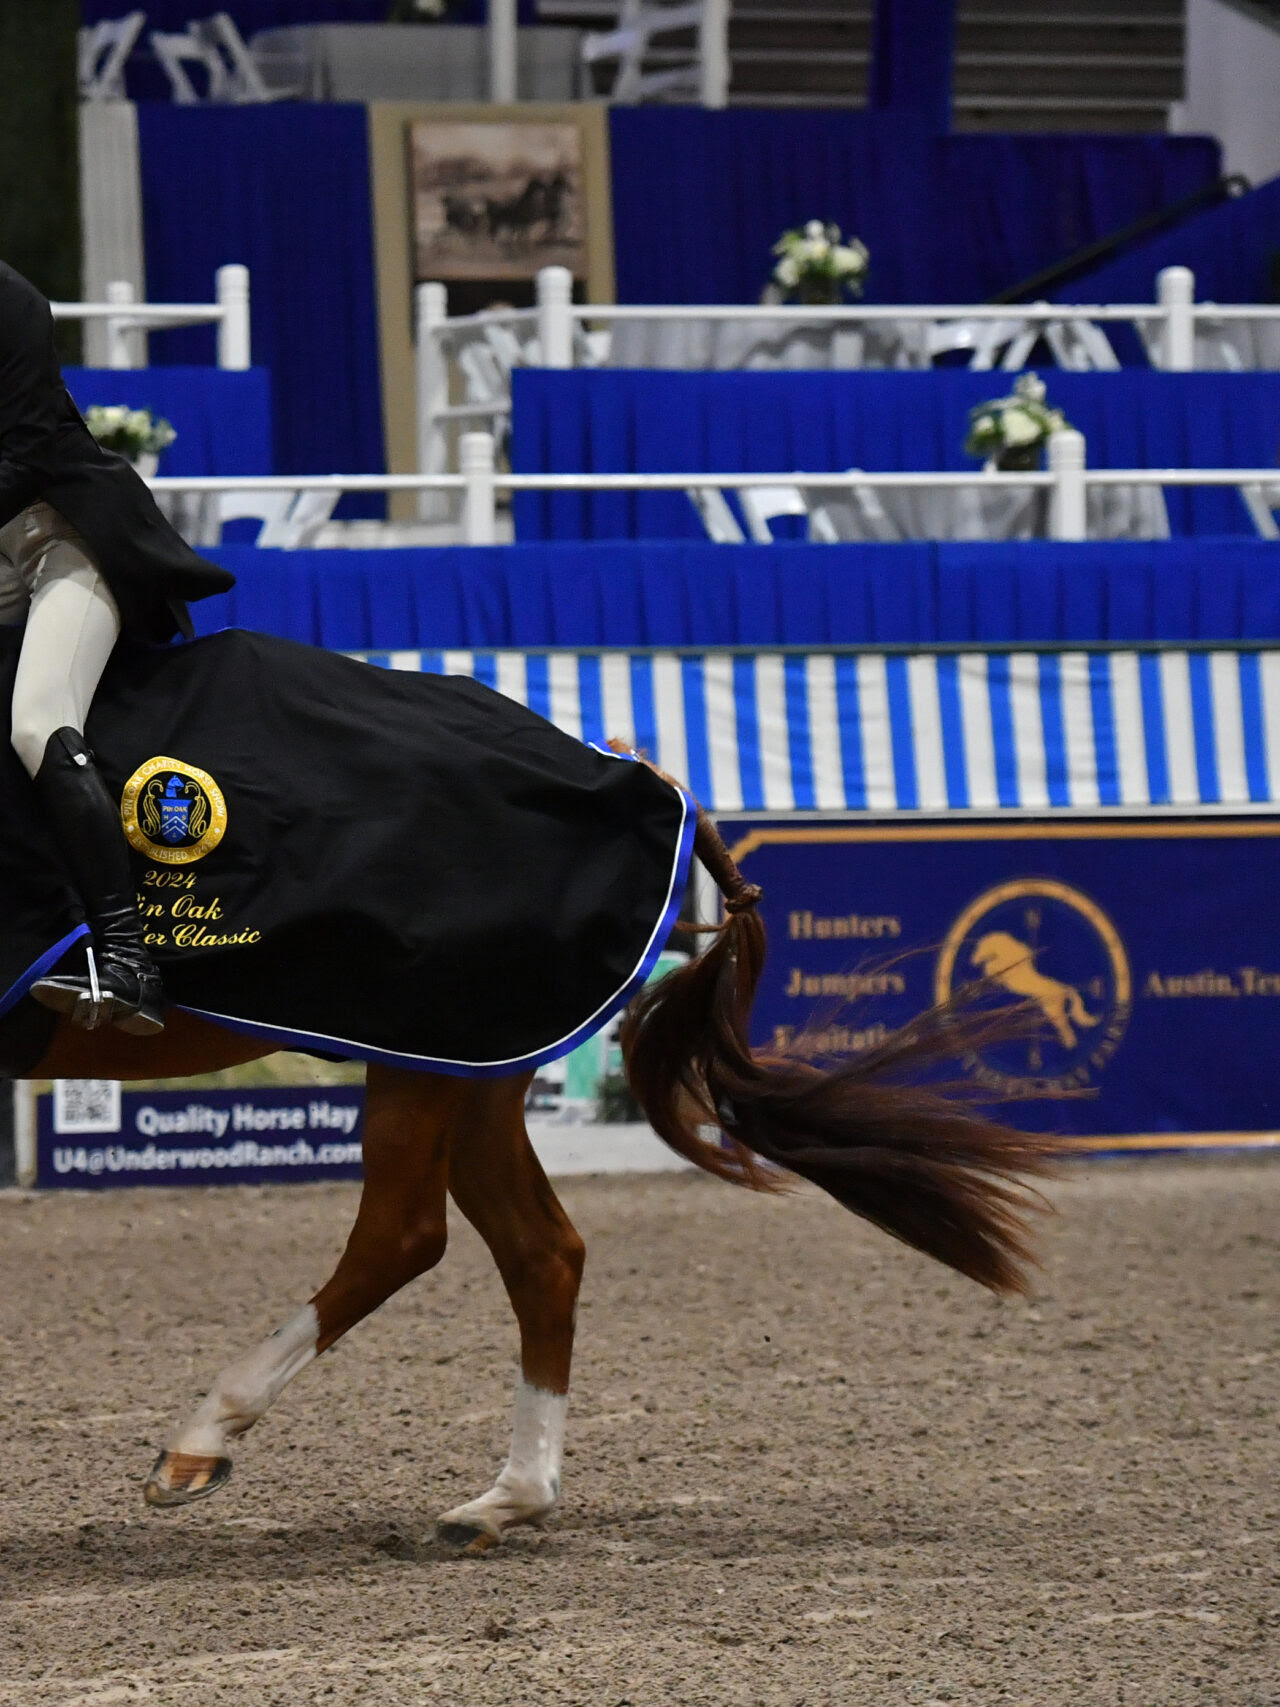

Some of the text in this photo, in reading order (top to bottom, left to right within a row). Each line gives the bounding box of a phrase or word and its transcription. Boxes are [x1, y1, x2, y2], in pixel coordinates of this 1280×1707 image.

[123, 760, 225, 817] PIN OAK CHARITY HORSE SHOW
[143, 870, 198, 889] 2024
[137, 892, 224, 920] in Oak
[172, 924, 262, 947] Classic
[789, 910, 902, 940] Hunters
[785, 967, 906, 1003] Jumpers
[136, 1101, 359, 1138] Quality Horse Hay
